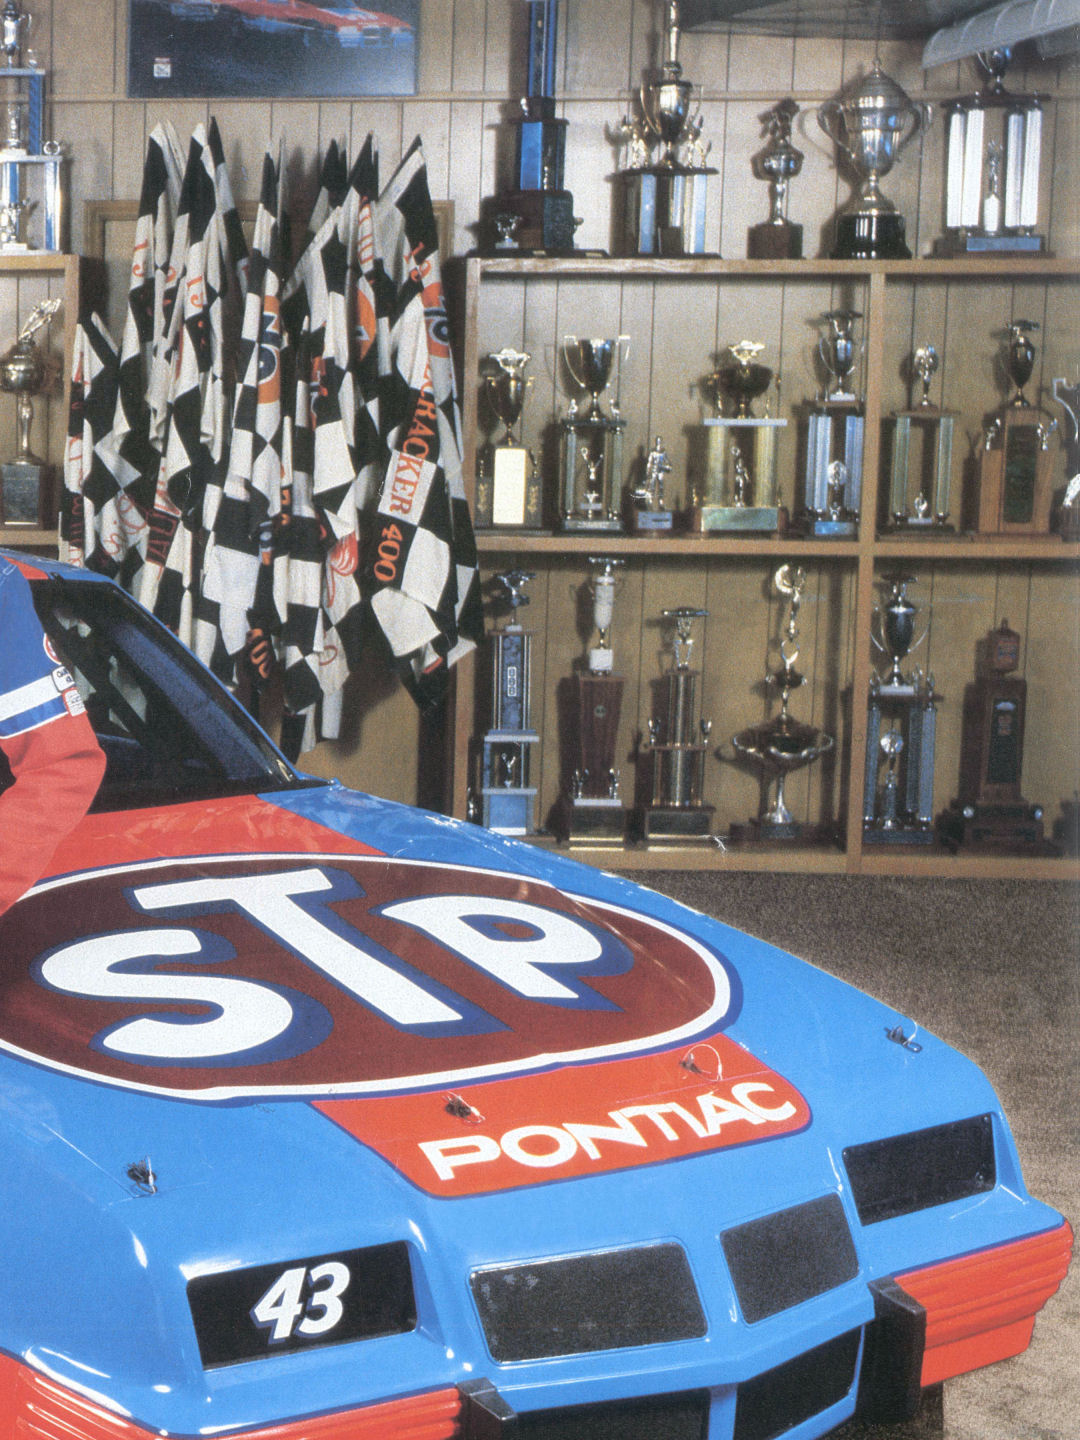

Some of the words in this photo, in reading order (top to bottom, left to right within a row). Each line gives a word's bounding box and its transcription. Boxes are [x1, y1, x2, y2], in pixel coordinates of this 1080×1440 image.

[373, 522, 405, 583] 400
[35, 867, 615, 1062] STP
[419, 1081, 798, 1180] PONTIAC
[250, 1260, 353, 1341] 43
